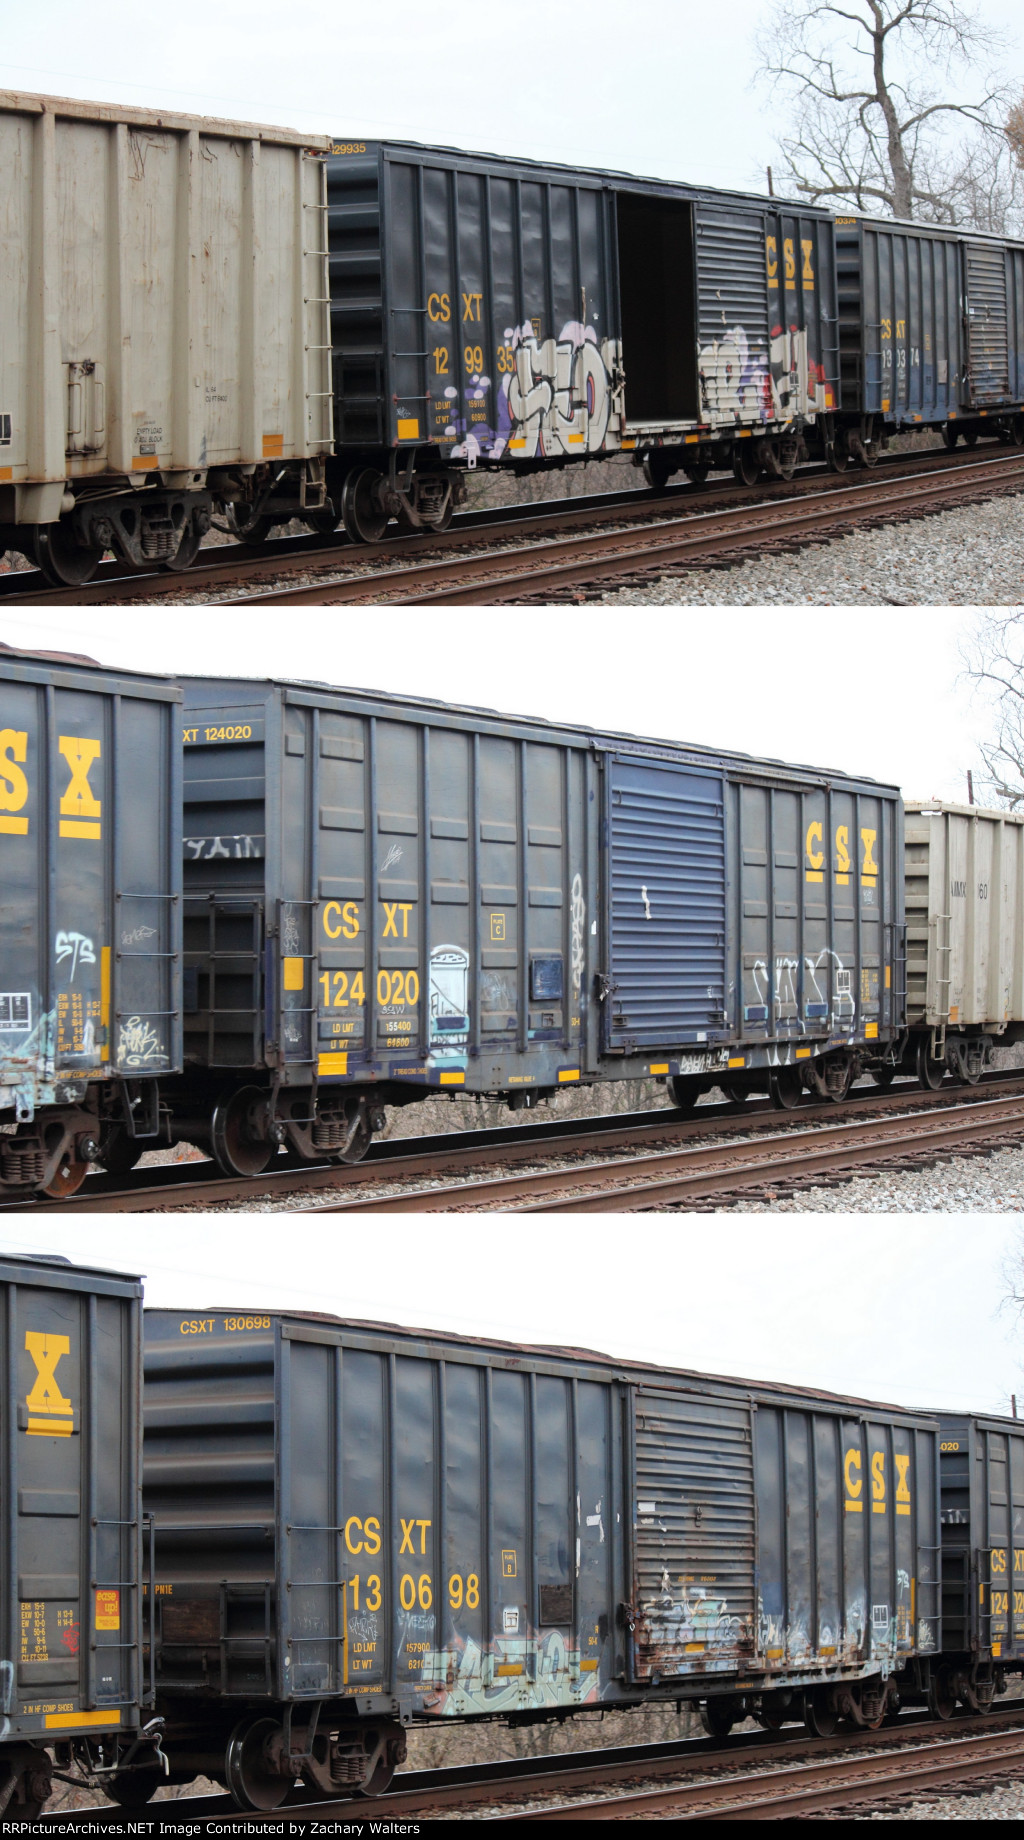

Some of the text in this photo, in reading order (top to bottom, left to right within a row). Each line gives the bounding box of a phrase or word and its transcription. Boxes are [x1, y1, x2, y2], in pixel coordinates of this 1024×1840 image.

[204, 726, 252, 741] 124020
[319, 969, 420, 1007] 124 020
[180, 1316, 271, 1334] CSXT 130698
[939, 1442, 960, 1452] 020
